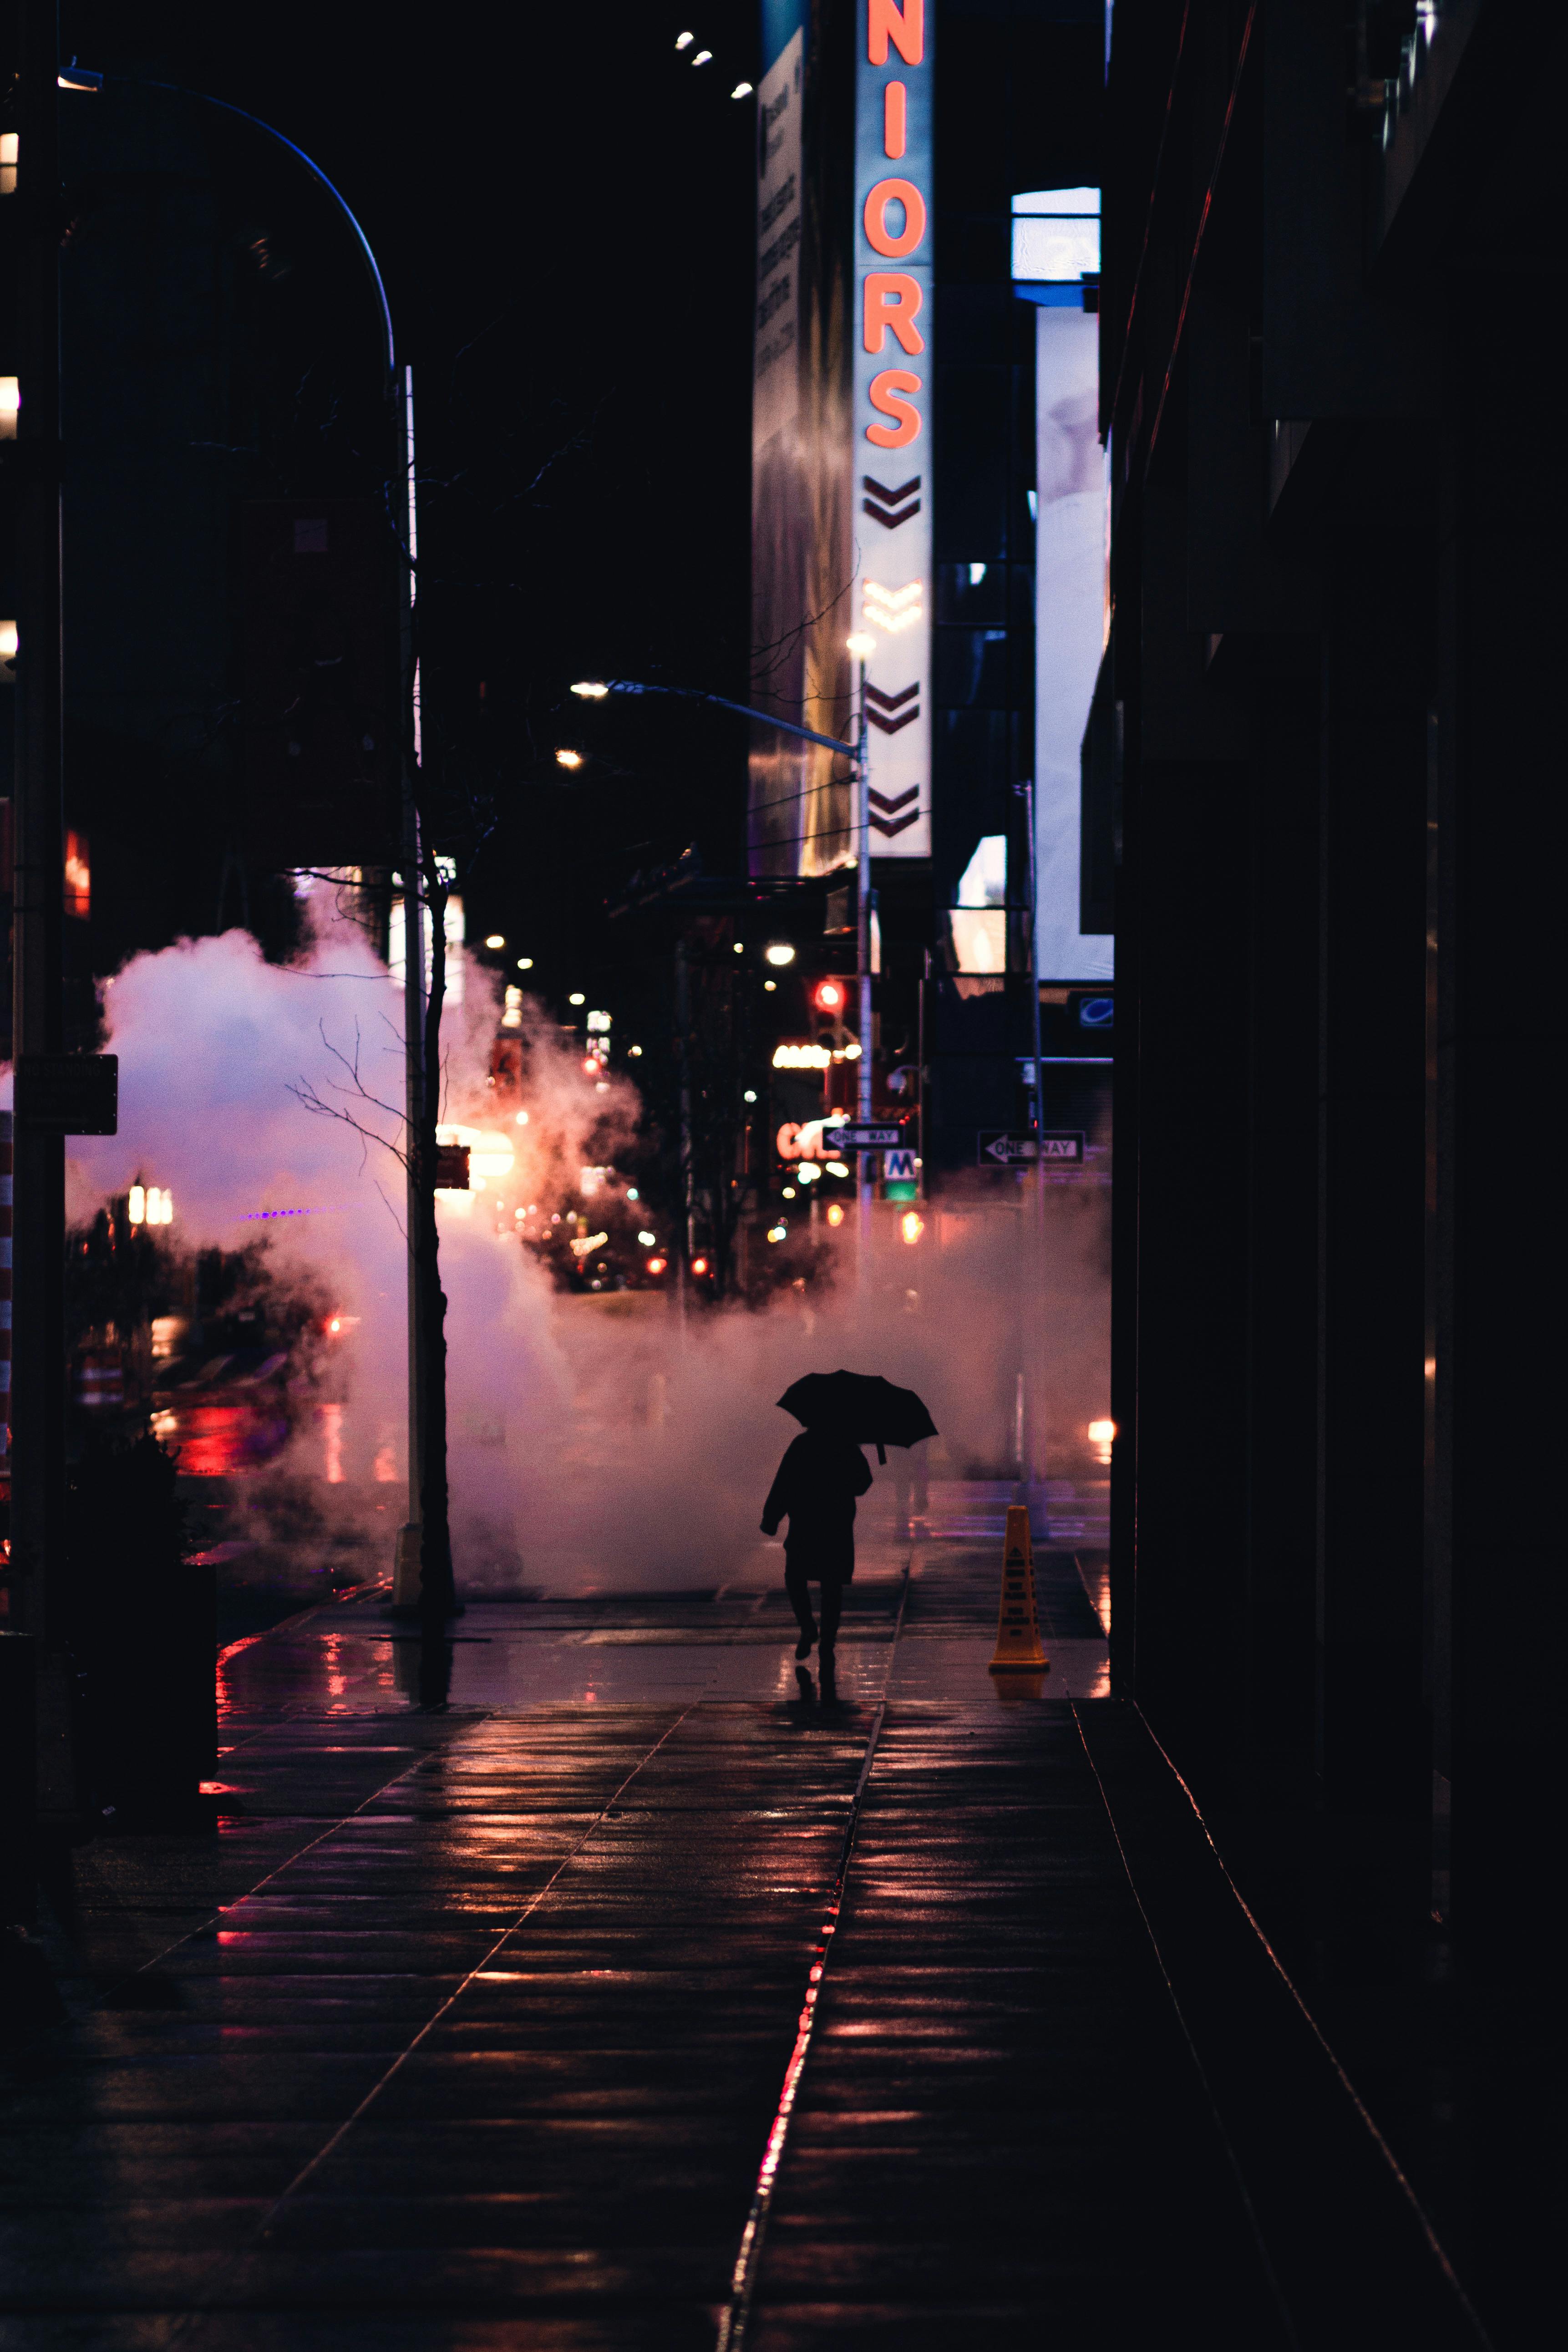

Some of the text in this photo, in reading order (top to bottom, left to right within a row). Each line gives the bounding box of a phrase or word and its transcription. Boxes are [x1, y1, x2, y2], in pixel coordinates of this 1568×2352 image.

[864, 0, 926, 448] NIORS
[834, 1129, 893, 1142] ONE WAY
[995, 1142, 1024, 1155] ONE
